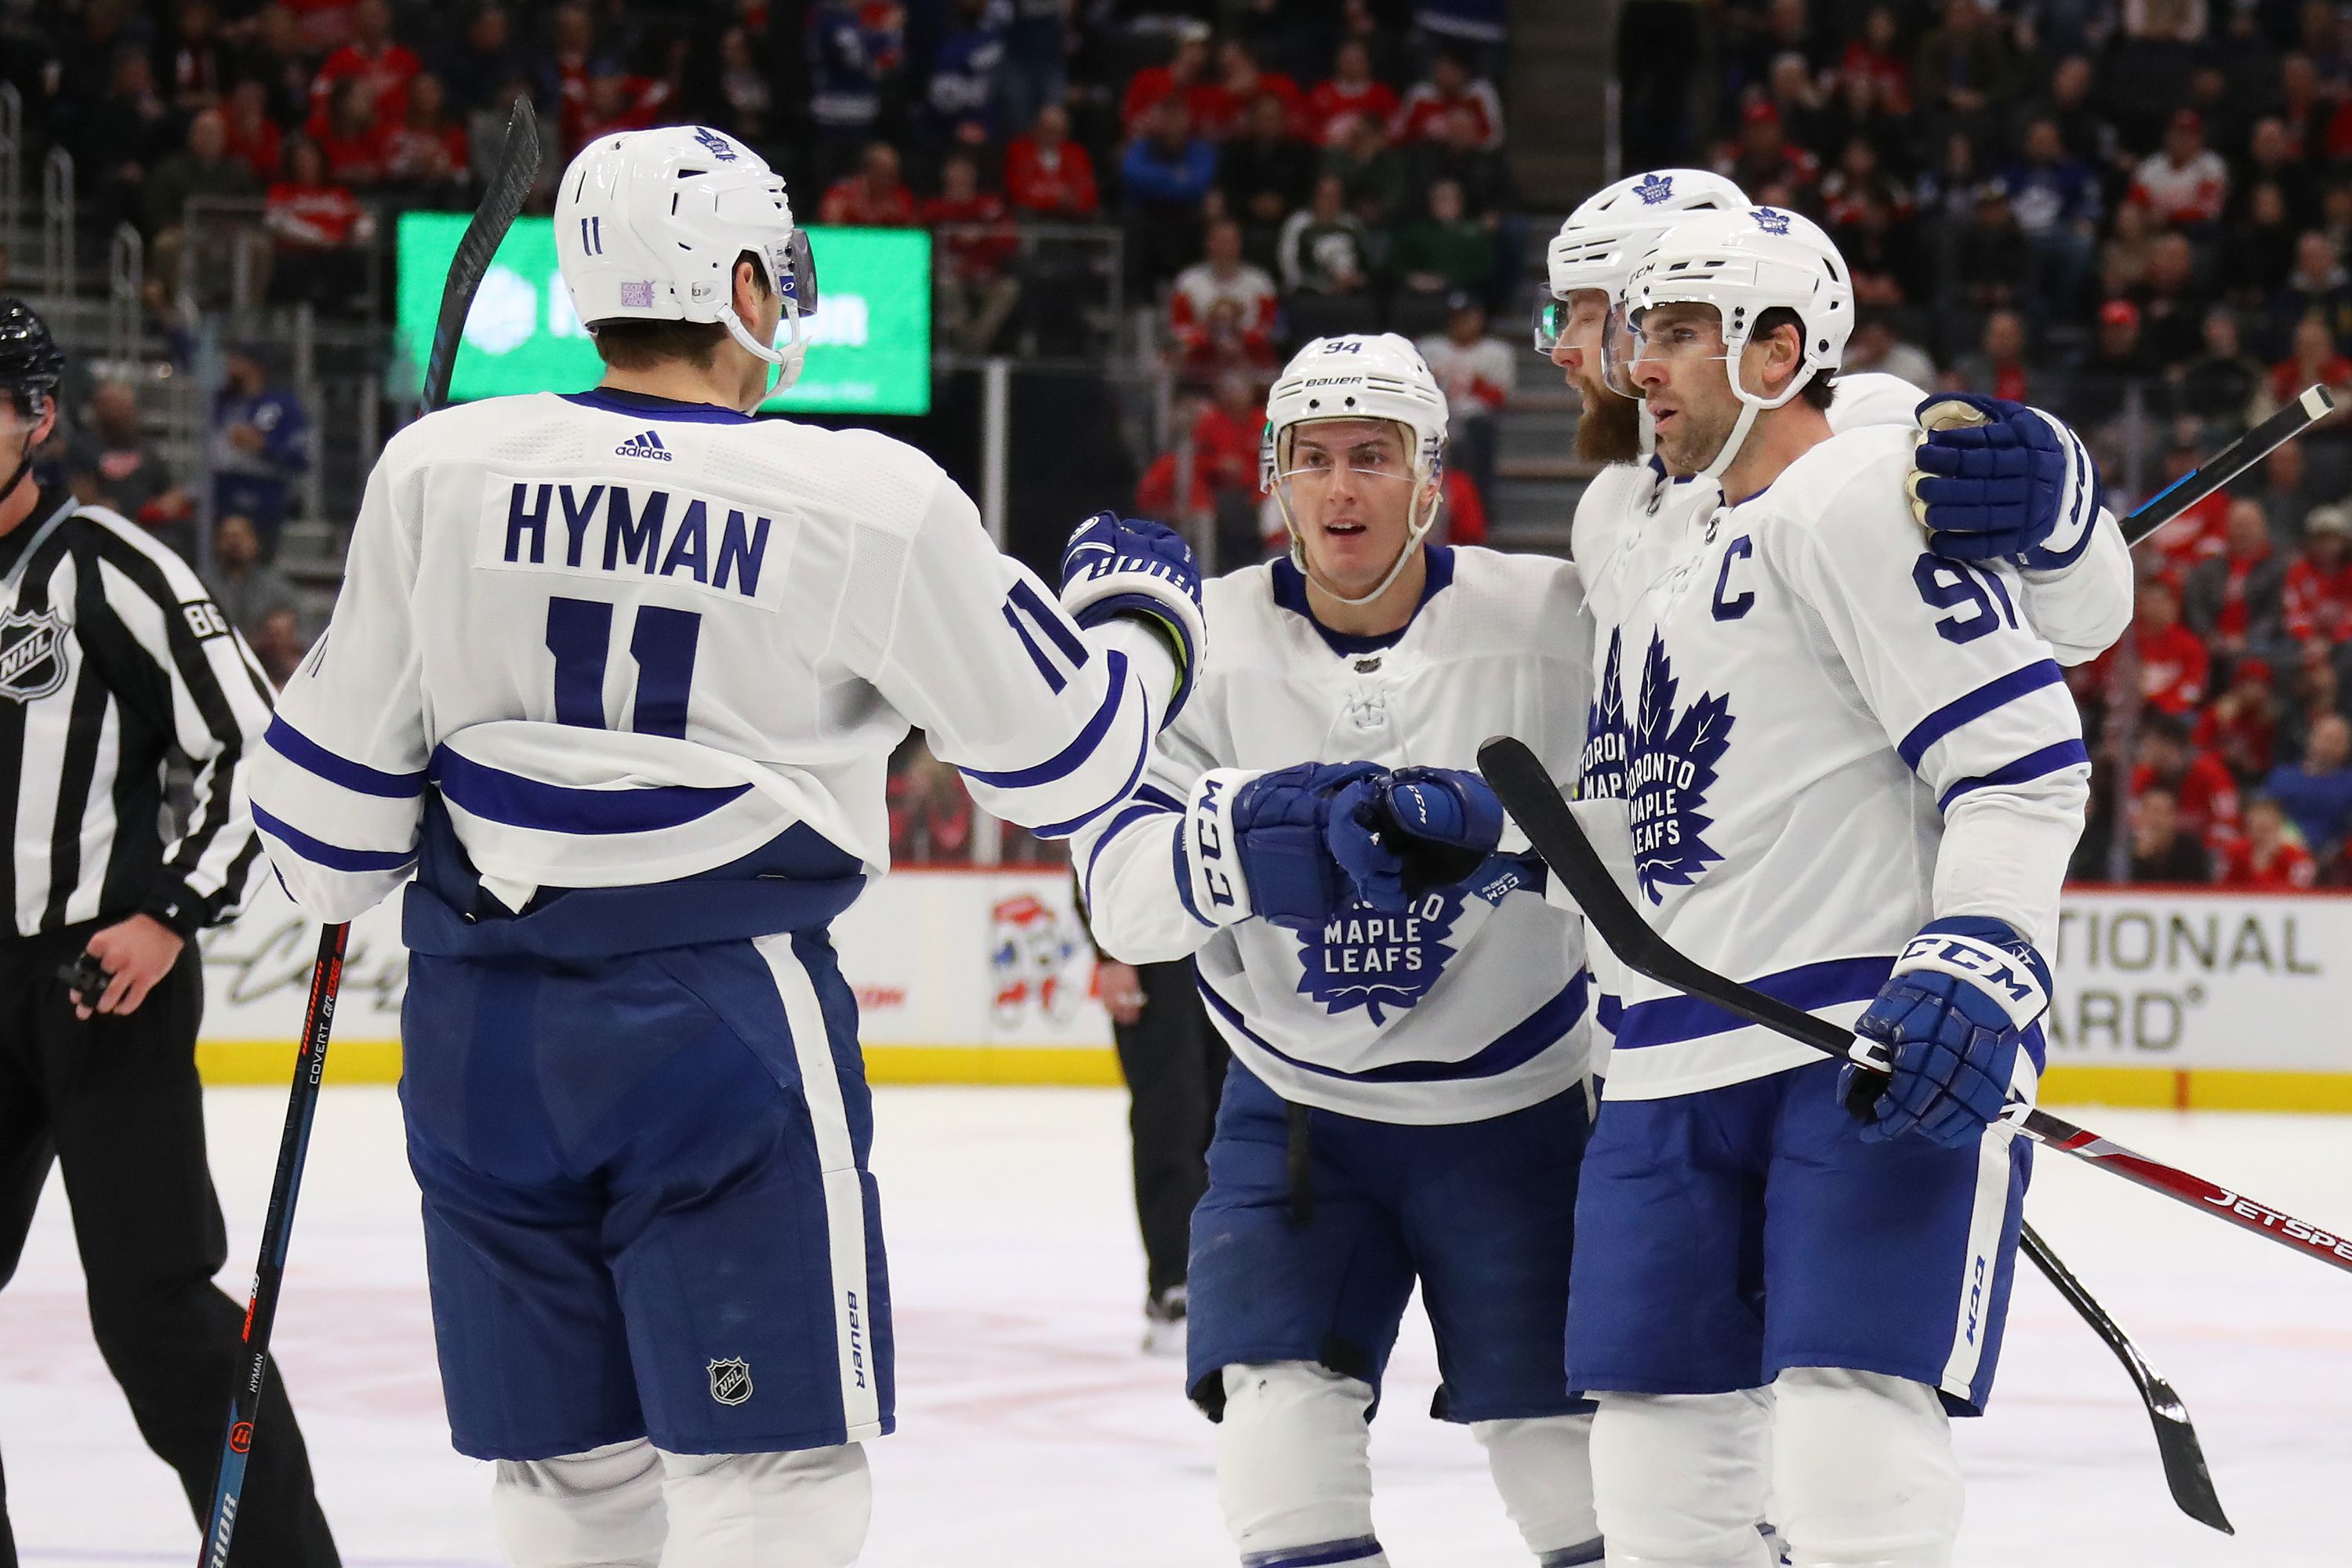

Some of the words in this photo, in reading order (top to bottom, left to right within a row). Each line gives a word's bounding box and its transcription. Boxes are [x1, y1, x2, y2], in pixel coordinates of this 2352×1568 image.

[581, 216, 603, 256] 11
[1629, 262, 1657, 285] CCM
[1323, 341, 1363, 354] 94
[1305, 376, 1363, 387] BAUER
[615, 445, 673, 462] adidas
[504, 483, 772, 597] HYMAN
[1711, 535, 1755, 622] C
[1912, 552, 2020, 645] 91
[0, 633, 51, 679] NHL
[1002, 578, 1089, 695] 11
[546, 596, 702, 740] 11
[1581, 732, 1627, 779] TORON
[1625, 752, 1696, 801] TORONTO
[1405, 785, 1427, 824] CCM
[1584, 772, 1622, 800] MAP
[1631, 788, 1678, 826] MAPLE
[1196, 779, 1236, 908] CCM
[1632, 819, 1681, 857] LEAFS
[1486, 876, 1519, 901] CCM
[1323, 917, 1422, 945] MAPLE
[1324, 946, 1423, 974] LEAFS
[1900, 938, 2033, 1003] CCM
[309, 1022, 328, 1085] COVERT
[2203, 1188, 2352, 1261] JETSPE
[1965, 1254, 1987, 1348] CCM
[847, 1290, 866, 1389] BAUER
[249, 1352, 264, 1393] HYMAN
[718, 1369, 744, 1396] NHL
